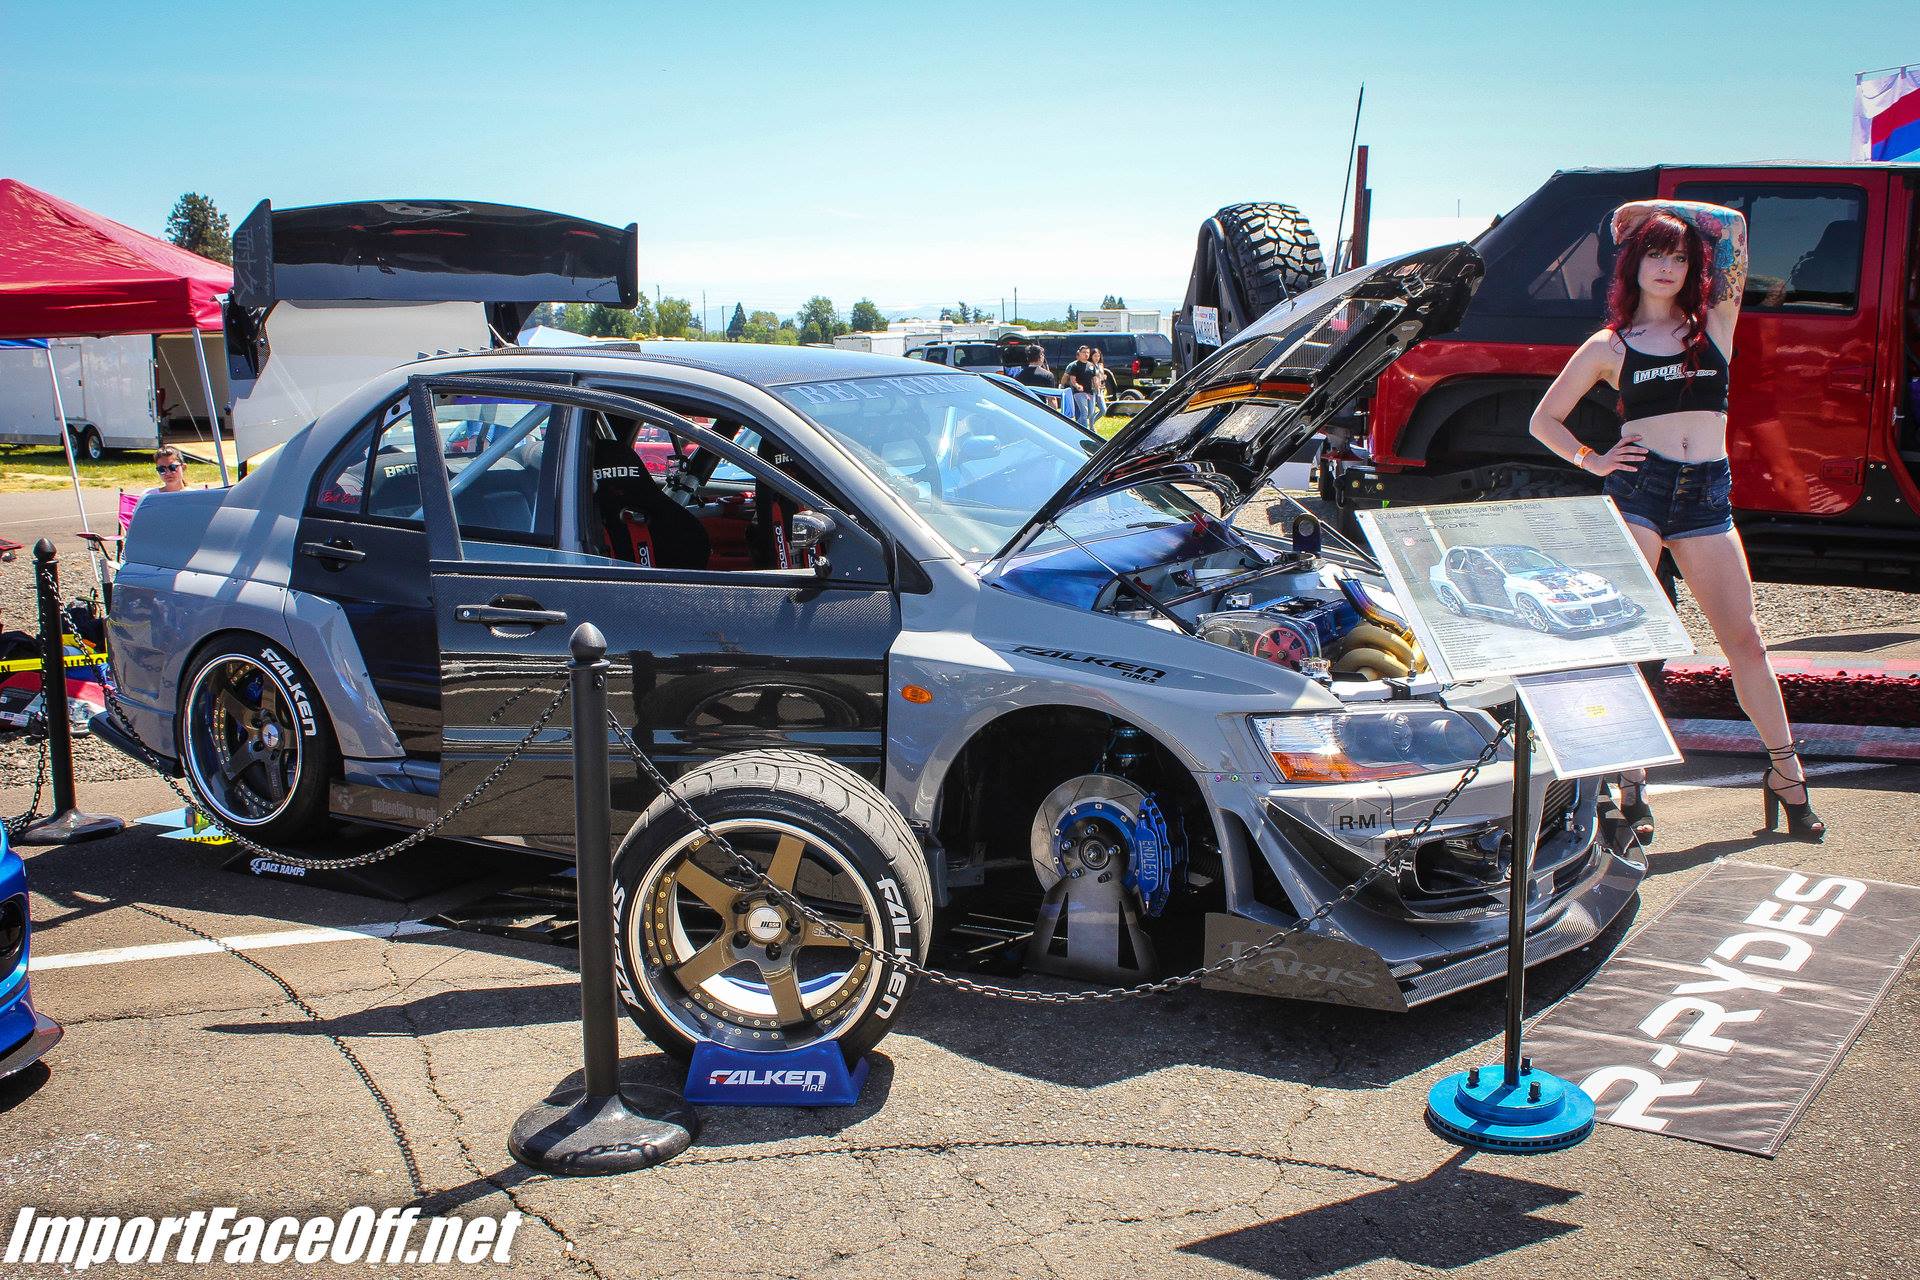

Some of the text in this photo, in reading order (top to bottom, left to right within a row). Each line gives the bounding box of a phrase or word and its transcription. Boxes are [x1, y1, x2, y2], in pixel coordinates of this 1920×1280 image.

[383, 464, 418, 478] BRID
[593, 466, 640, 480] BRIDE
[775, 525, 788, 569] parco
[1010, 643, 1167, 679] FALKEN
[1121, 671, 1157, 683] TIRES
[261, 648, 317, 736] FALKEN
[1340, 814, 1376, 830] R-M
[1142, 841, 1158, 880] ENDLESS
[260, 862, 306, 877] RACE RAMPS
[877, 874, 912, 1020] FALKEN
[1579, 872, 1869, 1130] R-RYDES
[706, 1070, 827, 1086] FALKEN
[801, 1084, 824, 1092] TIRE
